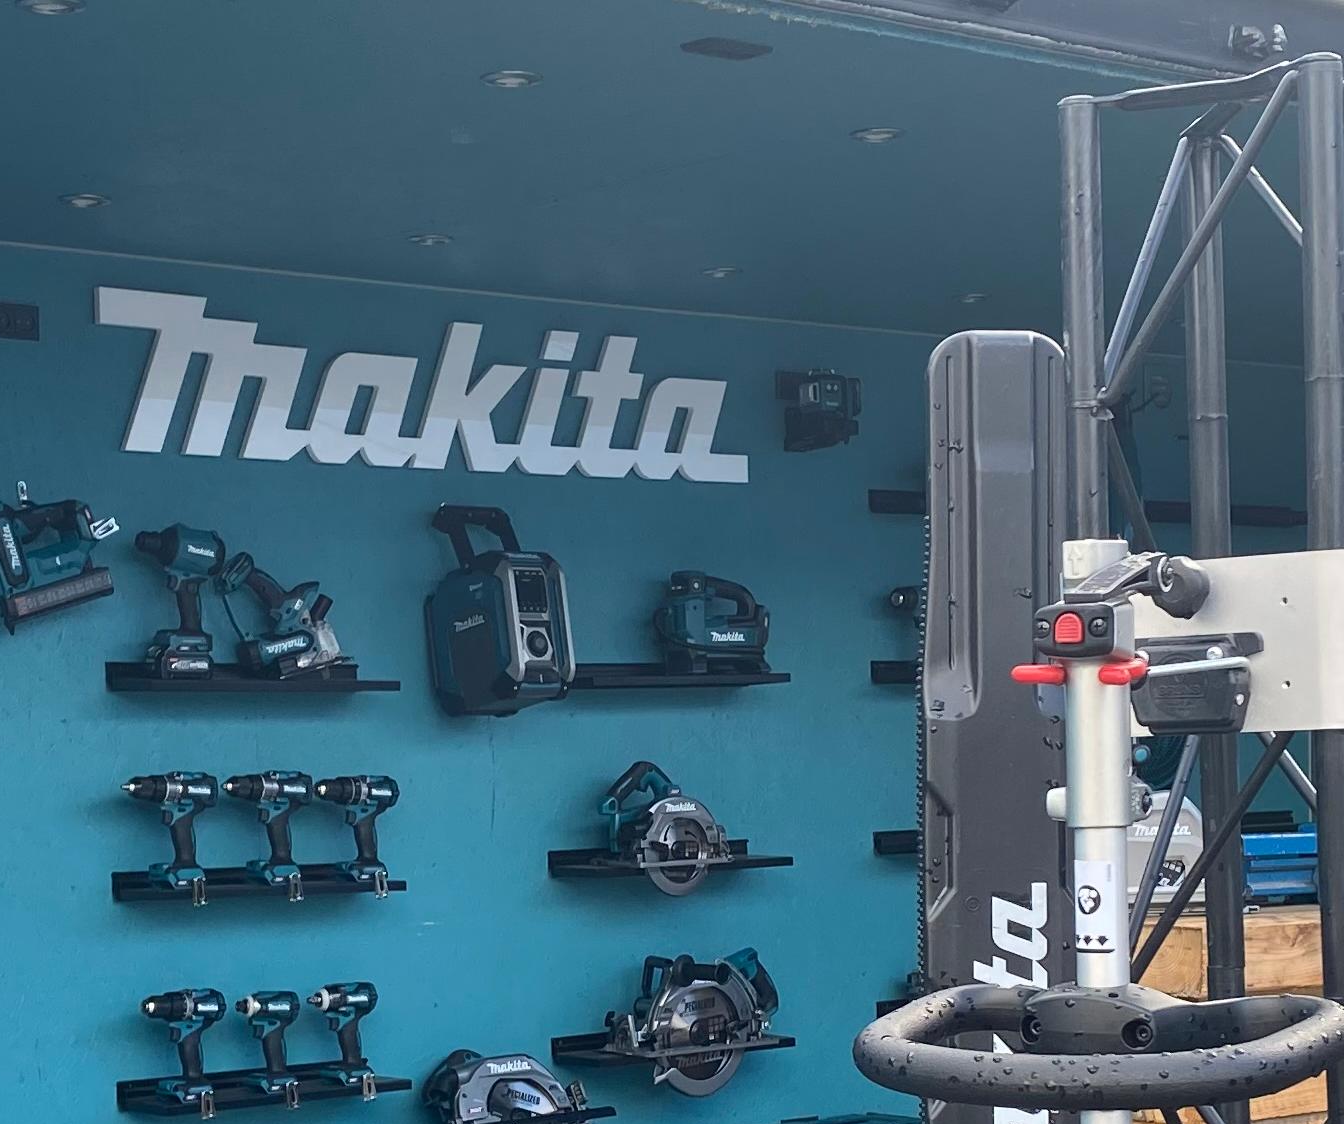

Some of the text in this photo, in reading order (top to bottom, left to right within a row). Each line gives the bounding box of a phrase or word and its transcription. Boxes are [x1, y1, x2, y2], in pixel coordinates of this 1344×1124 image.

[95, 286, 749, 483] Makita
[3, 523, 21, 570] Makita
[710, 631, 745, 641] Makita
[665, 802, 697, 812] Makita
[1133, 822, 1192, 836] Mata
[487, 1060, 531, 1074] Makita
